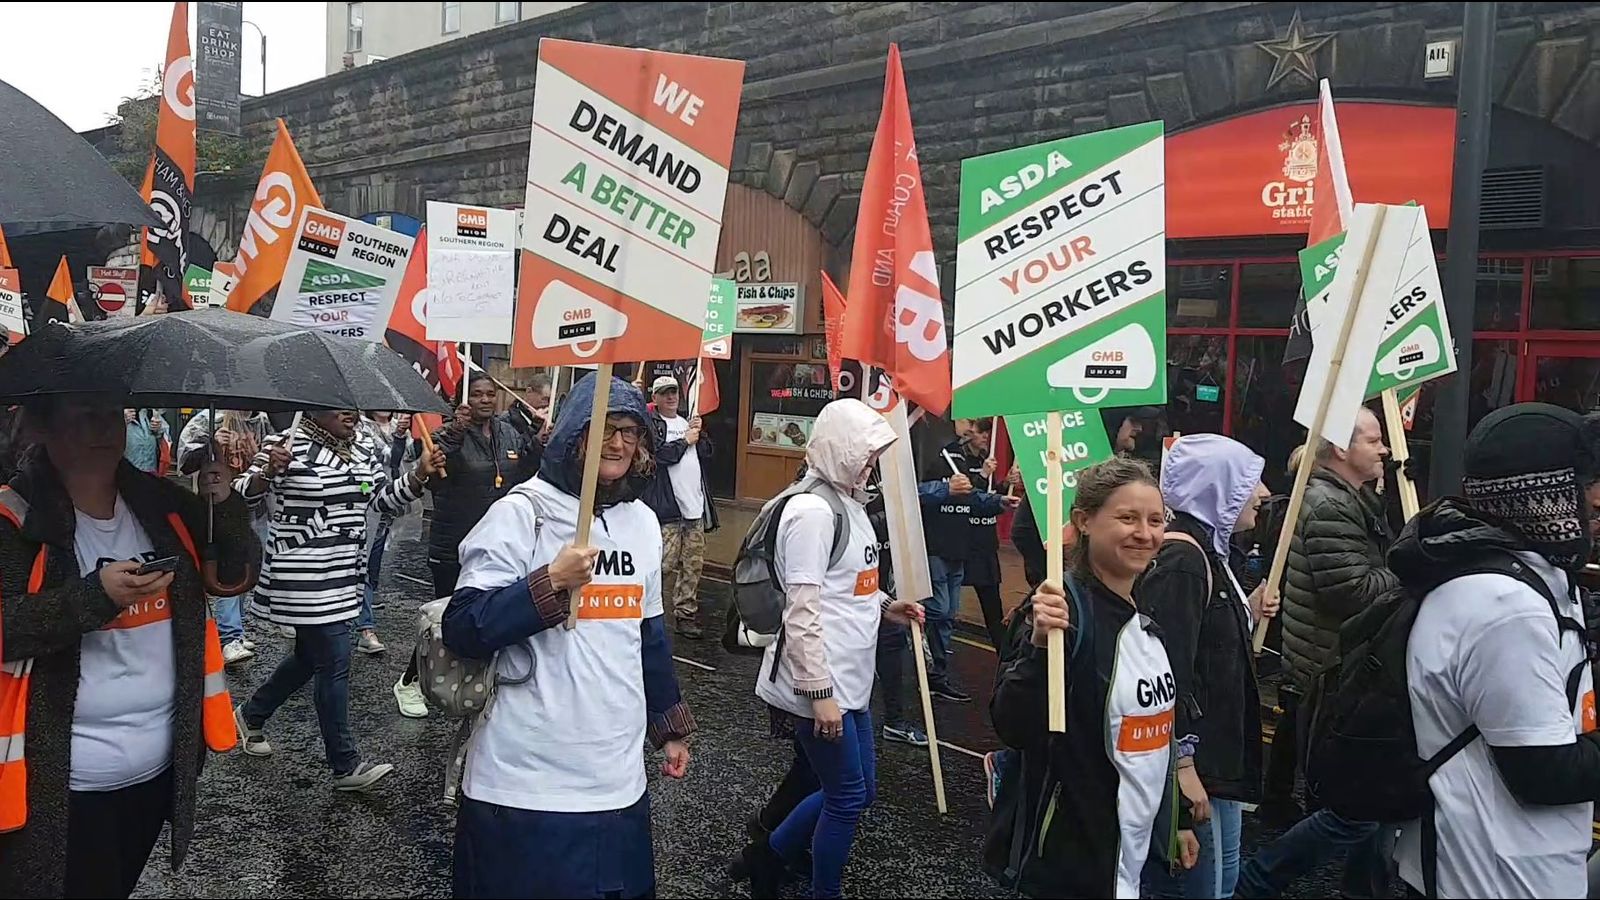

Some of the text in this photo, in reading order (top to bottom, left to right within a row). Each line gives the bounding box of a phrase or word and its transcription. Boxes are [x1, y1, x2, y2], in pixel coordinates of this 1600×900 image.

[210, 29, 230, 39] EAT
[202, 36, 238, 51] DRINK
[204, 45, 235, 59] SHOP
[653, 73, 704, 126] WE
[569, 100, 702, 194] DEMAND
[980, 150, 1073, 215] ASDA
[560, 162, 696, 249] A BETTER
[458, 214, 486, 226] GMB
[984, 170, 1122, 260] RESPECT
[305, 220, 341, 241] GMB
[458, 229, 487, 237] UNION
[300, 240, 336, 255] UNION
[347, 231, 408, 257] SOUTHERN
[440, 236, 504, 248] SOUTHERN REGION
[542, 213, 621, 273] DEAL
[351, 247, 395, 268] REGION
[999, 235, 1096, 295] YOUR
[1314, 245, 1344, 282] AS
[311, 273, 352, 287] ASDA
[309, 291, 367, 306] RESPECT
[738, 287, 795, 300] Fish & Chips
[563, 308, 592, 321] GMB
[982, 260, 1152, 355] WORKERS
[311, 310, 349, 323] YOUR
[563, 326, 592, 335] UNION
[1092, 351, 1124, 362] GMB
[810, 389, 833, 399] CHIPS
[940, 505, 954, 513] NO
[592, 550, 635, 576] MB
[1137, 672, 1176, 708] GMB
